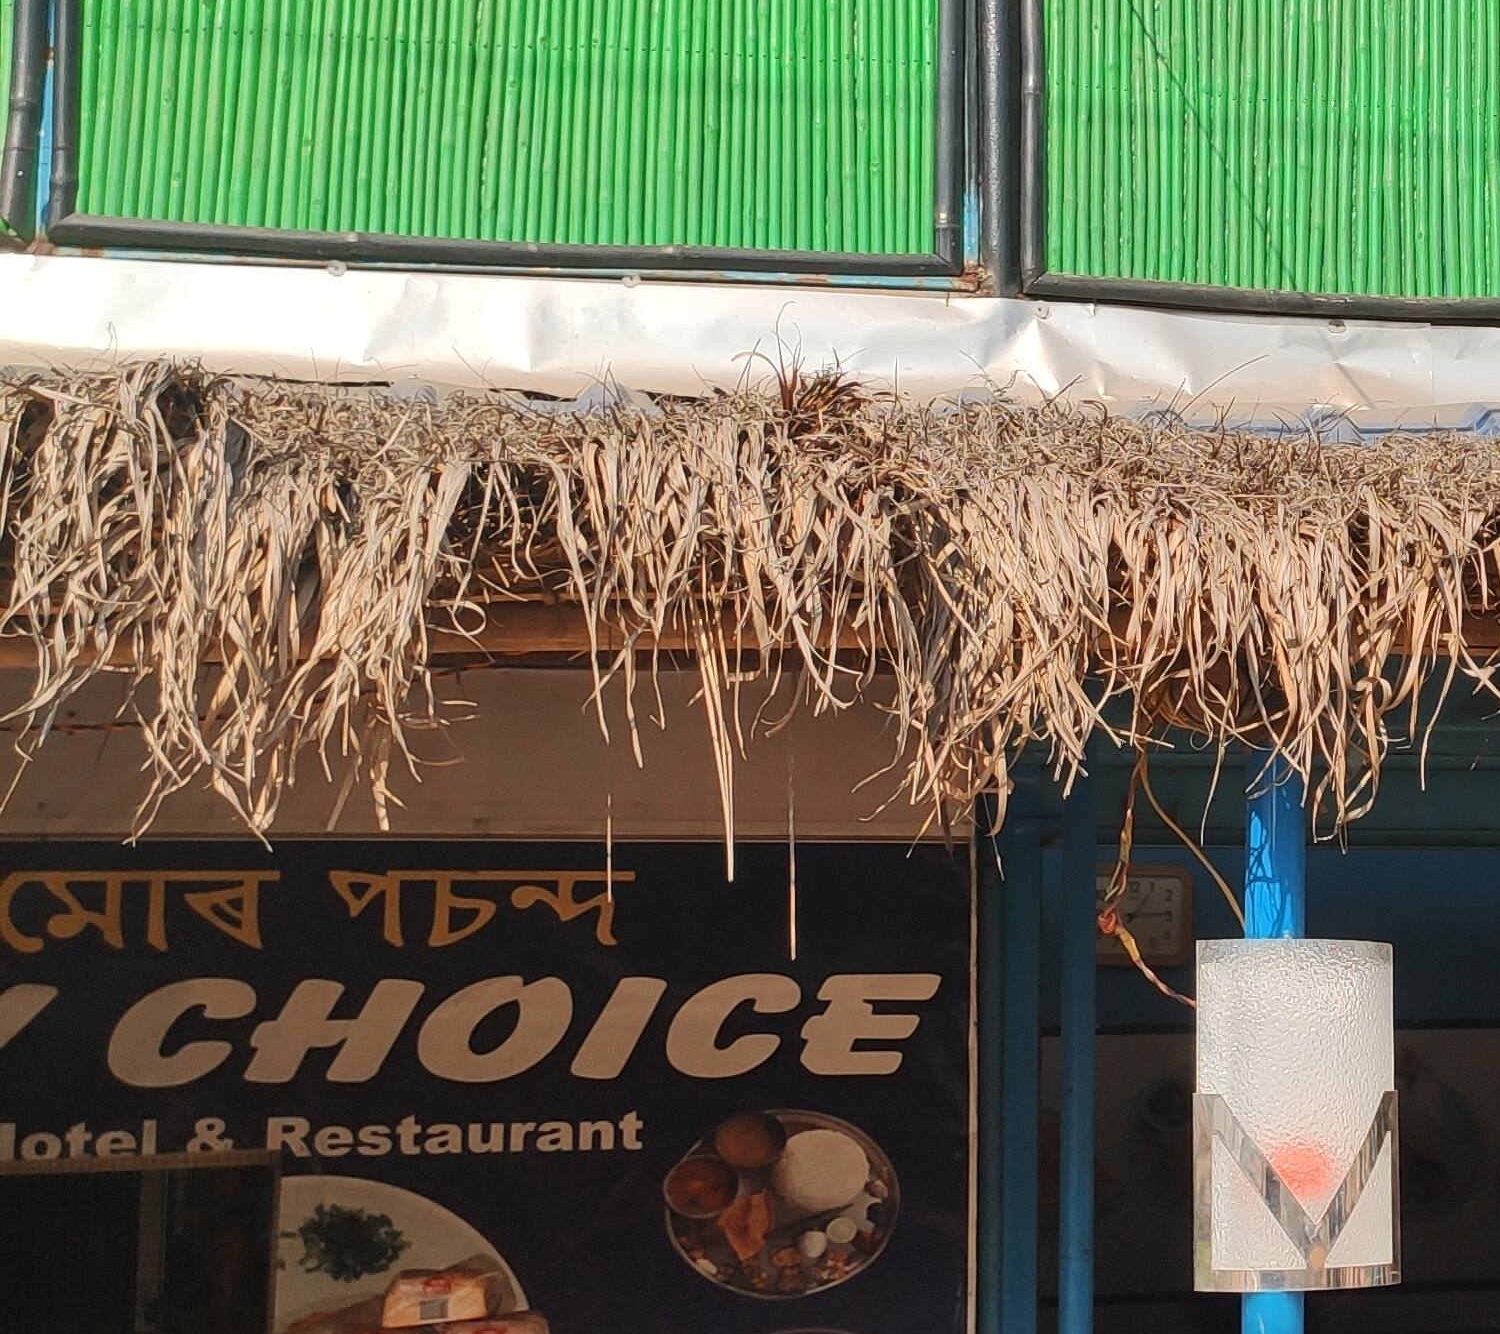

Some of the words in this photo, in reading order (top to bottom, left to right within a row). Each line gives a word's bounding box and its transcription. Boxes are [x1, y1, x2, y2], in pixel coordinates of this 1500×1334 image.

[0, 869, 281, 954] মোৰ
[328, 869, 636, 948] পচন্দ
[106, 973, 942, 1089] CHOICE
[187, 1116, 233, 1153] &
[267, 1110, 645, 1157] Restaurant
